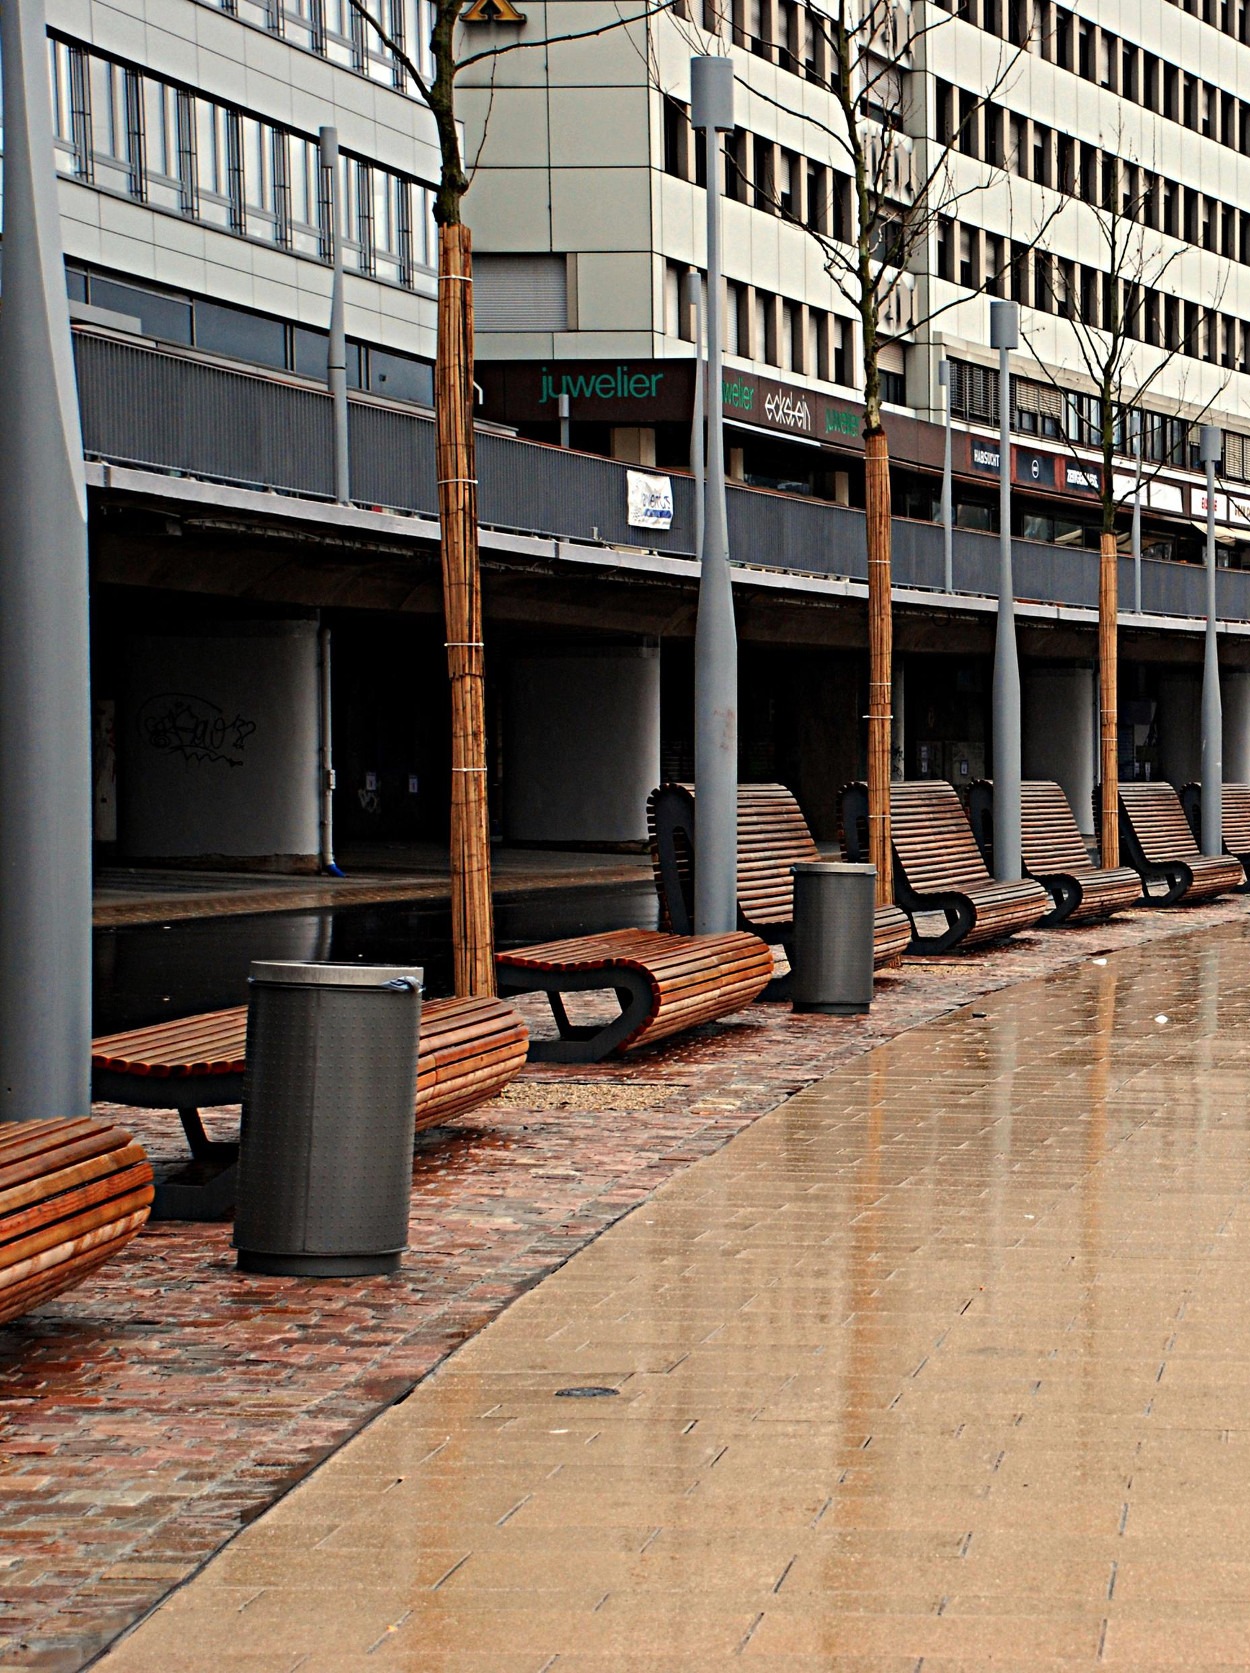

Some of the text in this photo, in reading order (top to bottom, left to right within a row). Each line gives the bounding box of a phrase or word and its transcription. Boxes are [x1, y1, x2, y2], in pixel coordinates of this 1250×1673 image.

[538, 366, 664, 403] juwelier
[764, 388, 812, 432] eckstein
[973, 448, 1000, 468] HABSUCHT
